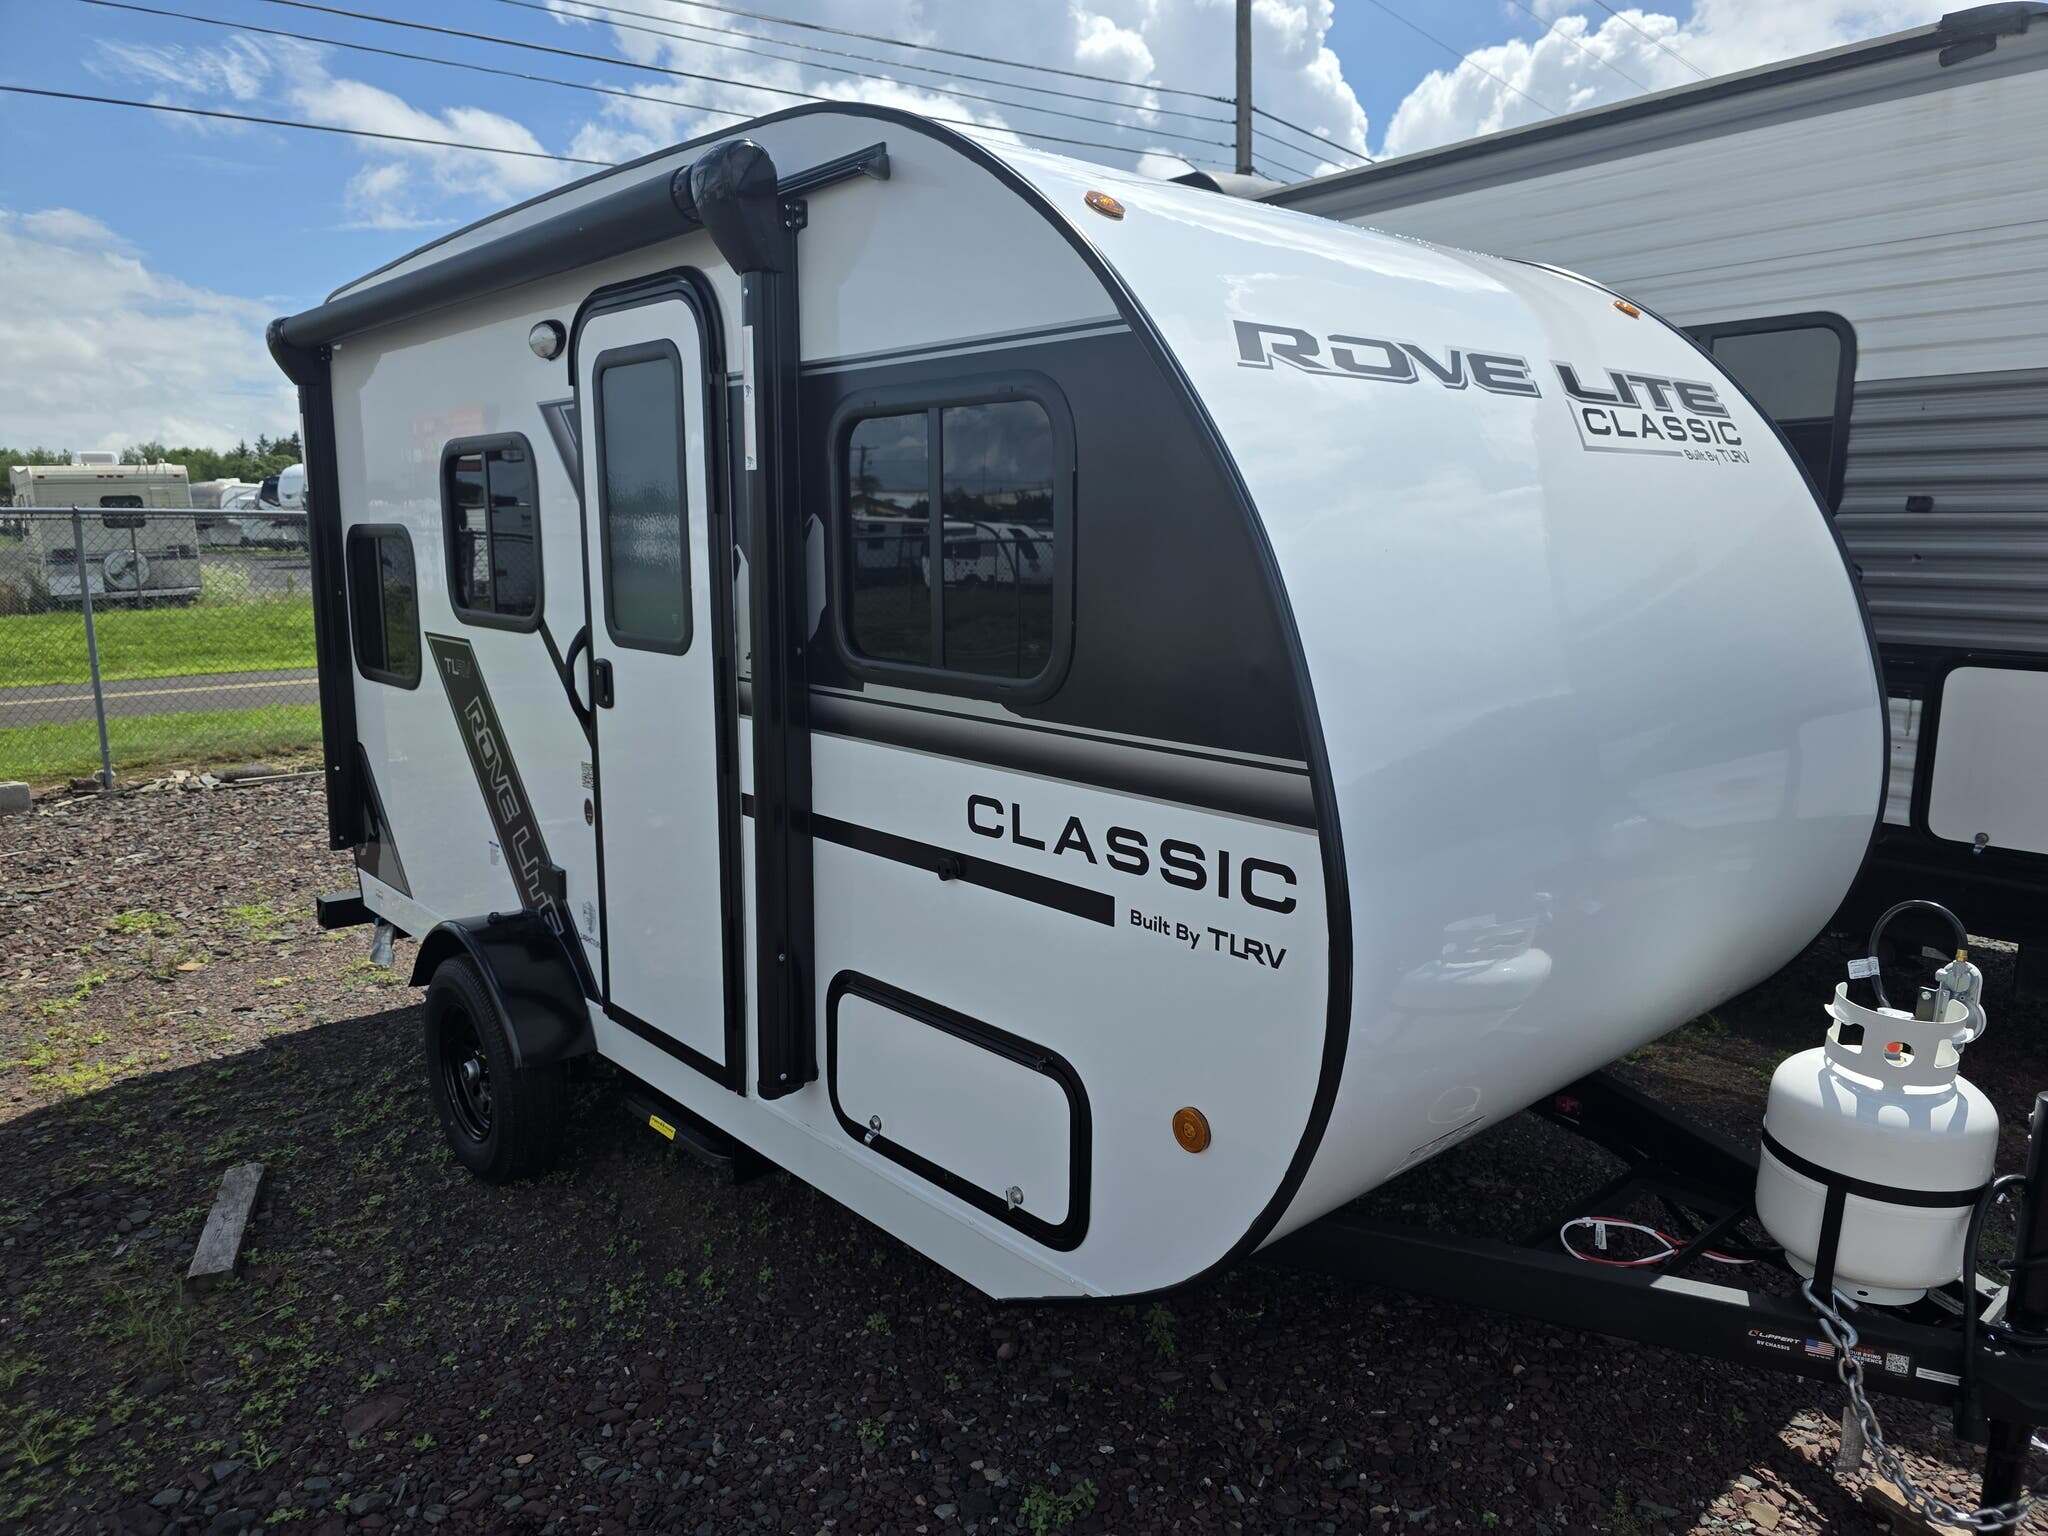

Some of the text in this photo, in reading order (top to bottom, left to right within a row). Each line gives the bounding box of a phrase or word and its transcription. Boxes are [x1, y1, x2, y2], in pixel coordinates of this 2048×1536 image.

[1233, 319, 1730, 418] ROVE LITE
[1583, 407, 1742, 446] CLASSIC
[1683, 449, 1750, 465] Built By TLRV
[464, 695, 521, 823] ROVE
[967, 794, 1297, 915] CLASSIC
[1130, 908, 1288, 970] Built By TLRV
[1765, 1341, 1791, 1351] CHASSIS
